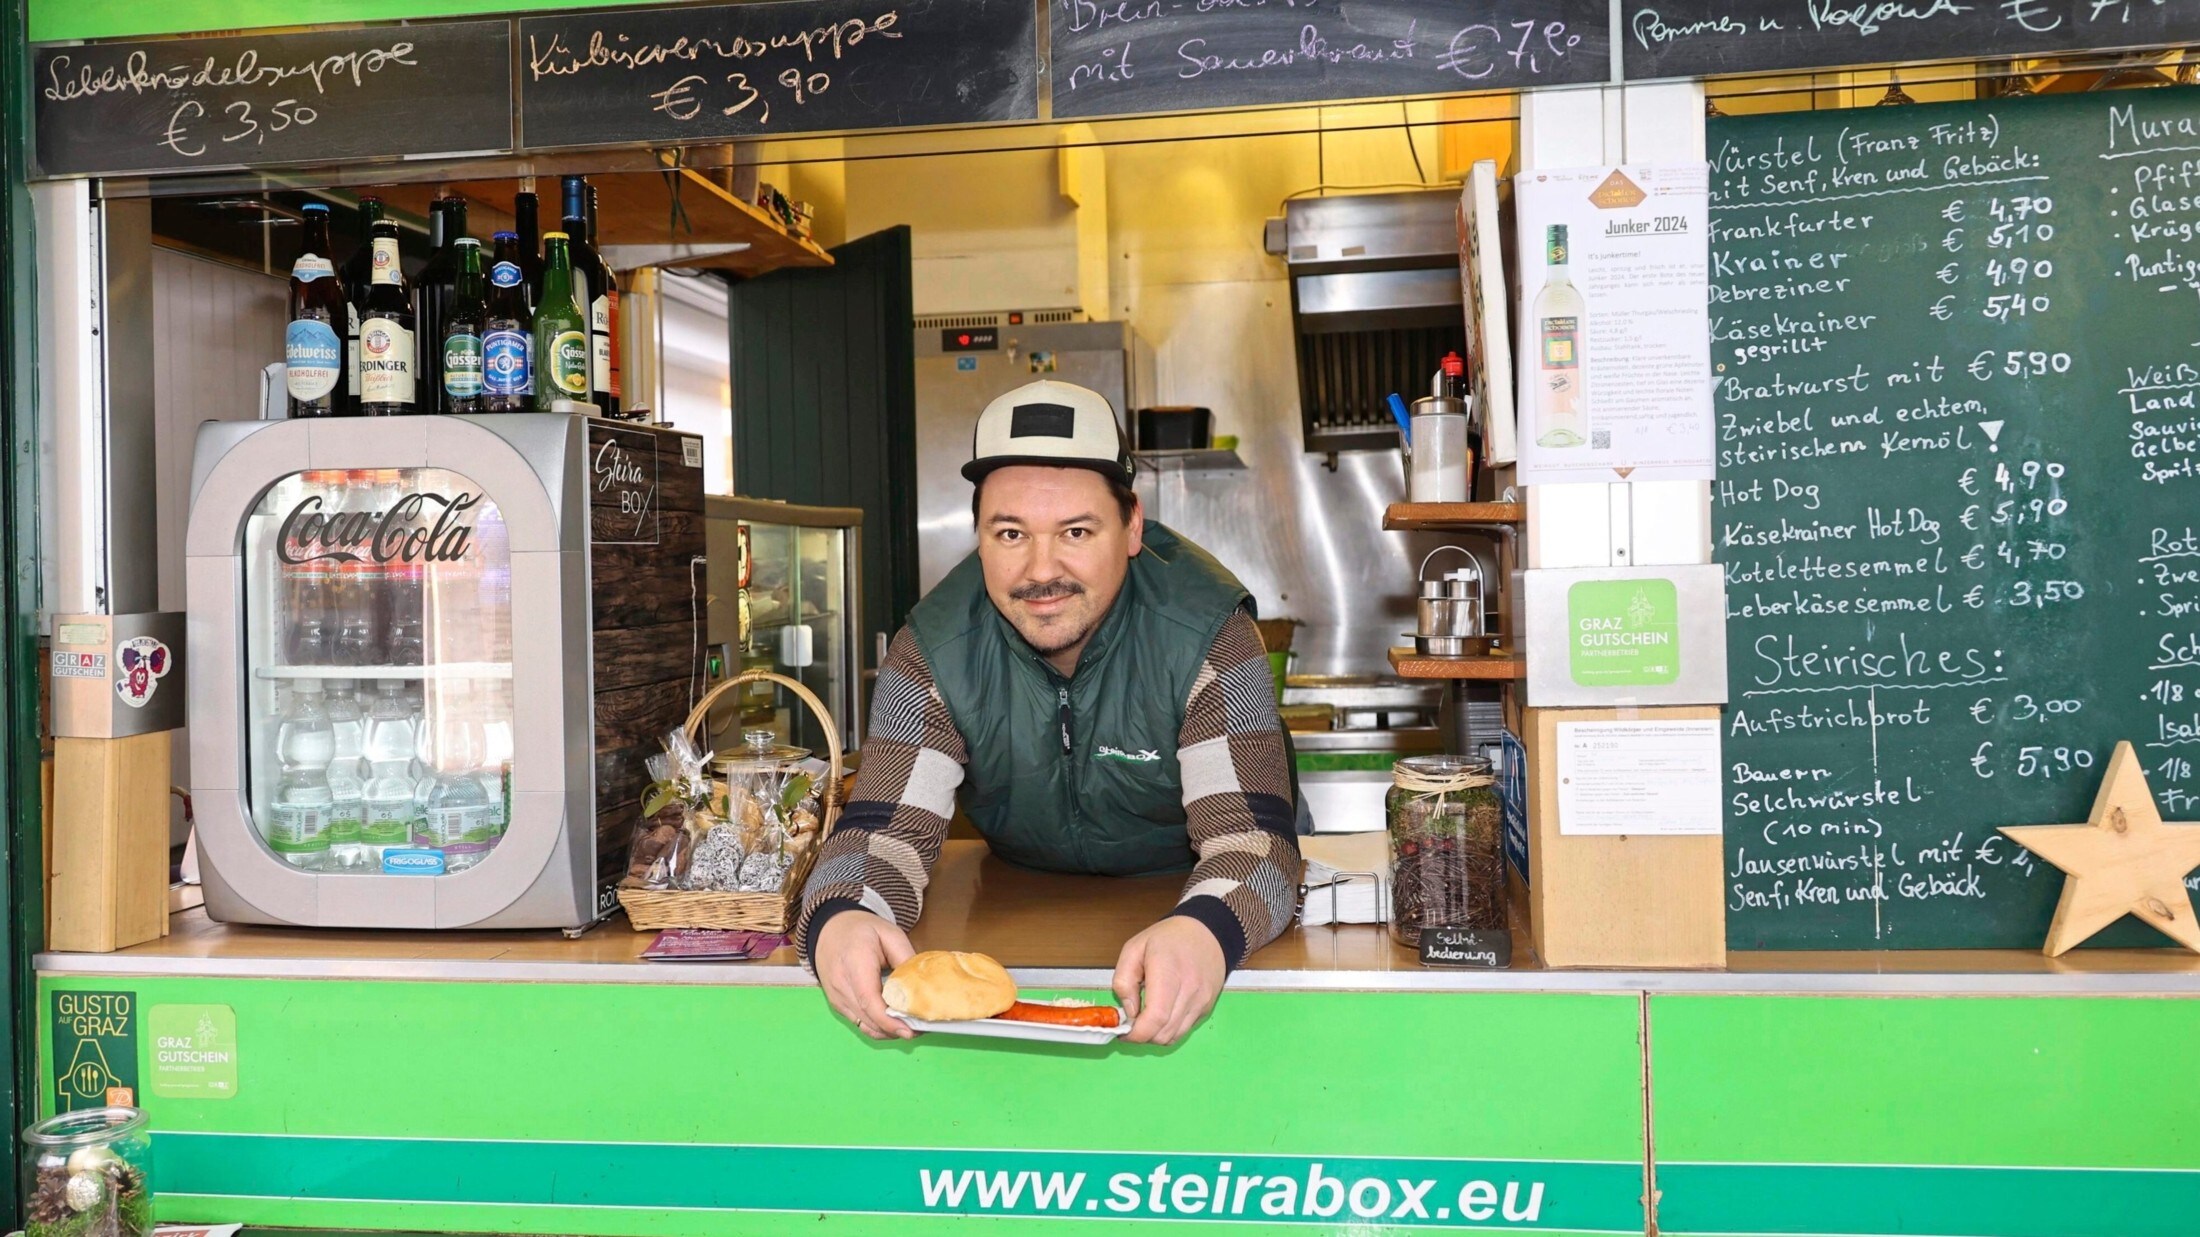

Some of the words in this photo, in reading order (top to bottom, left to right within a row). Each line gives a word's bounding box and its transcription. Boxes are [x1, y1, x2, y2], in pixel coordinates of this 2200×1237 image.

[1069, 41, 1134, 90] mit
[1435, 23, 1501, 79] €
[650, 75, 707, 120] €
[722, 68, 830, 124] 3,90
[157, 101, 206, 156] €
[222, 100, 318, 144] 3,50
[1838, 127, 1920, 165] (Franz
[1928, 113, 1999, 148] Fritz)
[1832, 166, 1879, 188] Kren
[1885, 158, 1929, 182] und
[1943, 146, 2041, 180] Gebäck:
[1605, 219, 1650, 235] Junker
[1654, 216, 1688, 232] 2024
[1706, 210, 1874, 244] Frankfurter
[1941, 200, 1965, 223] €
[1988, 196, 2052, 223] 4,70
[1712, 250, 1848, 278] Krainer
[1942, 228, 1964, 252] €
[1988, 224, 2053, 249] 5,10
[1707, 277, 1851, 305] Debreziner
[1935, 262, 1959, 284] €
[1985, 257, 2053, 286] 4,90
[1708, 311, 1877, 343] Käsekrainer
[1929, 295, 1956, 320] €
[1982, 294, 2050, 323] 5,40
[286, 344, 337, 360] Edelweiss
[446, 350, 481, 368] Gösser
[486, 339, 524, 351] PUNTIGAMER
[1734, 337, 1827, 366] gegrillt
[360, 360, 408, 373] ERDINGER
[1724, 364, 1869, 401] Bratwurst
[1887, 355, 1945, 387] mit
[1967, 351, 1995, 381] €
[2003, 351, 2072, 380] 5,90
[2130, 390, 2195, 414] Land
[1722, 408, 1813, 441] Zwiebel
[1831, 406, 1883, 429] und
[1881, 425, 1973, 459] Kernöl
[2131, 436, 2196, 458] Gelbe
[595, 439, 644, 492] Steira
[1720, 479, 1763, 507] Hot
[1773, 478, 1821, 509] Dog
[1957, 467, 1980, 496] €
[1994, 461, 2065, 494] 4,90
[622, 485, 654, 536] BOX
[1724, 519, 1857, 547] Käsekrainer
[1959, 505, 1980, 531] €
[1991, 498, 2068, 525] 5,90
[276, 492, 484, 565] Coca-Cola
[2151, 526, 2198, 556] Rot
[1722, 546, 1948, 585] Kotelettesemmel
[1960, 544, 1984, 570] €
[1997, 539, 2066, 568] 4,70
[1723, 583, 1953, 620] Leberkäsesemmel
[1963, 584, 1984, 609] €
[2009, 580, 2084, 608] 3,50
[1580, 617, 1623, 631] GRAZ
[1580, 632, 1668, 647] GUTSCHEIN
[55, 653, 104, 667] GRAZ
[55, 667, 104, 677] GUTSCHEIN
[1753, 632, 2004, 686] Steirisches:
[2150, 680, 2184, 705] 1/8
[1730, 699, 1931, 737] Aufstrichbrot
[1968, 697, 1995, 724] €
[2012, 694, 2082, 723] 3,00
[1733, 762, 1832, 784] Bauern
[1970, 741, 1994, 779] €
[2017, 746, 2093, 779] 5,90
[2157, 757, 2191, 782] 1/8
[1732, 777, 1922, 816] Selchwürstel
[1763, 820, 1812, 845] (10
[1820, 818, 1883, 838] min)
[389, 857, 438, 867] FRIGOGLASS
[1730, 843, 1906, 878] Jausenwürstel
[1919, 832, 1963, 863] mit
[1976, 836, 2003, 865] €
[1794, 878, 1840, 905] Kren
[1846, 873, 1889, 901] und
[1899, 864, 1986, 898] Gebäck
[1426, 947, 1496, 965] bedienung
[59, 995, 129, 1015] GUSTO
[73, 1016, 128, 1036] GRAZ
[158, 1037, 192, 1048] GRAZ
[158, 1051, 228, 1063] GUTSCHEIN
[919, 1161, 1546, 1221] www.steirabox.eu
